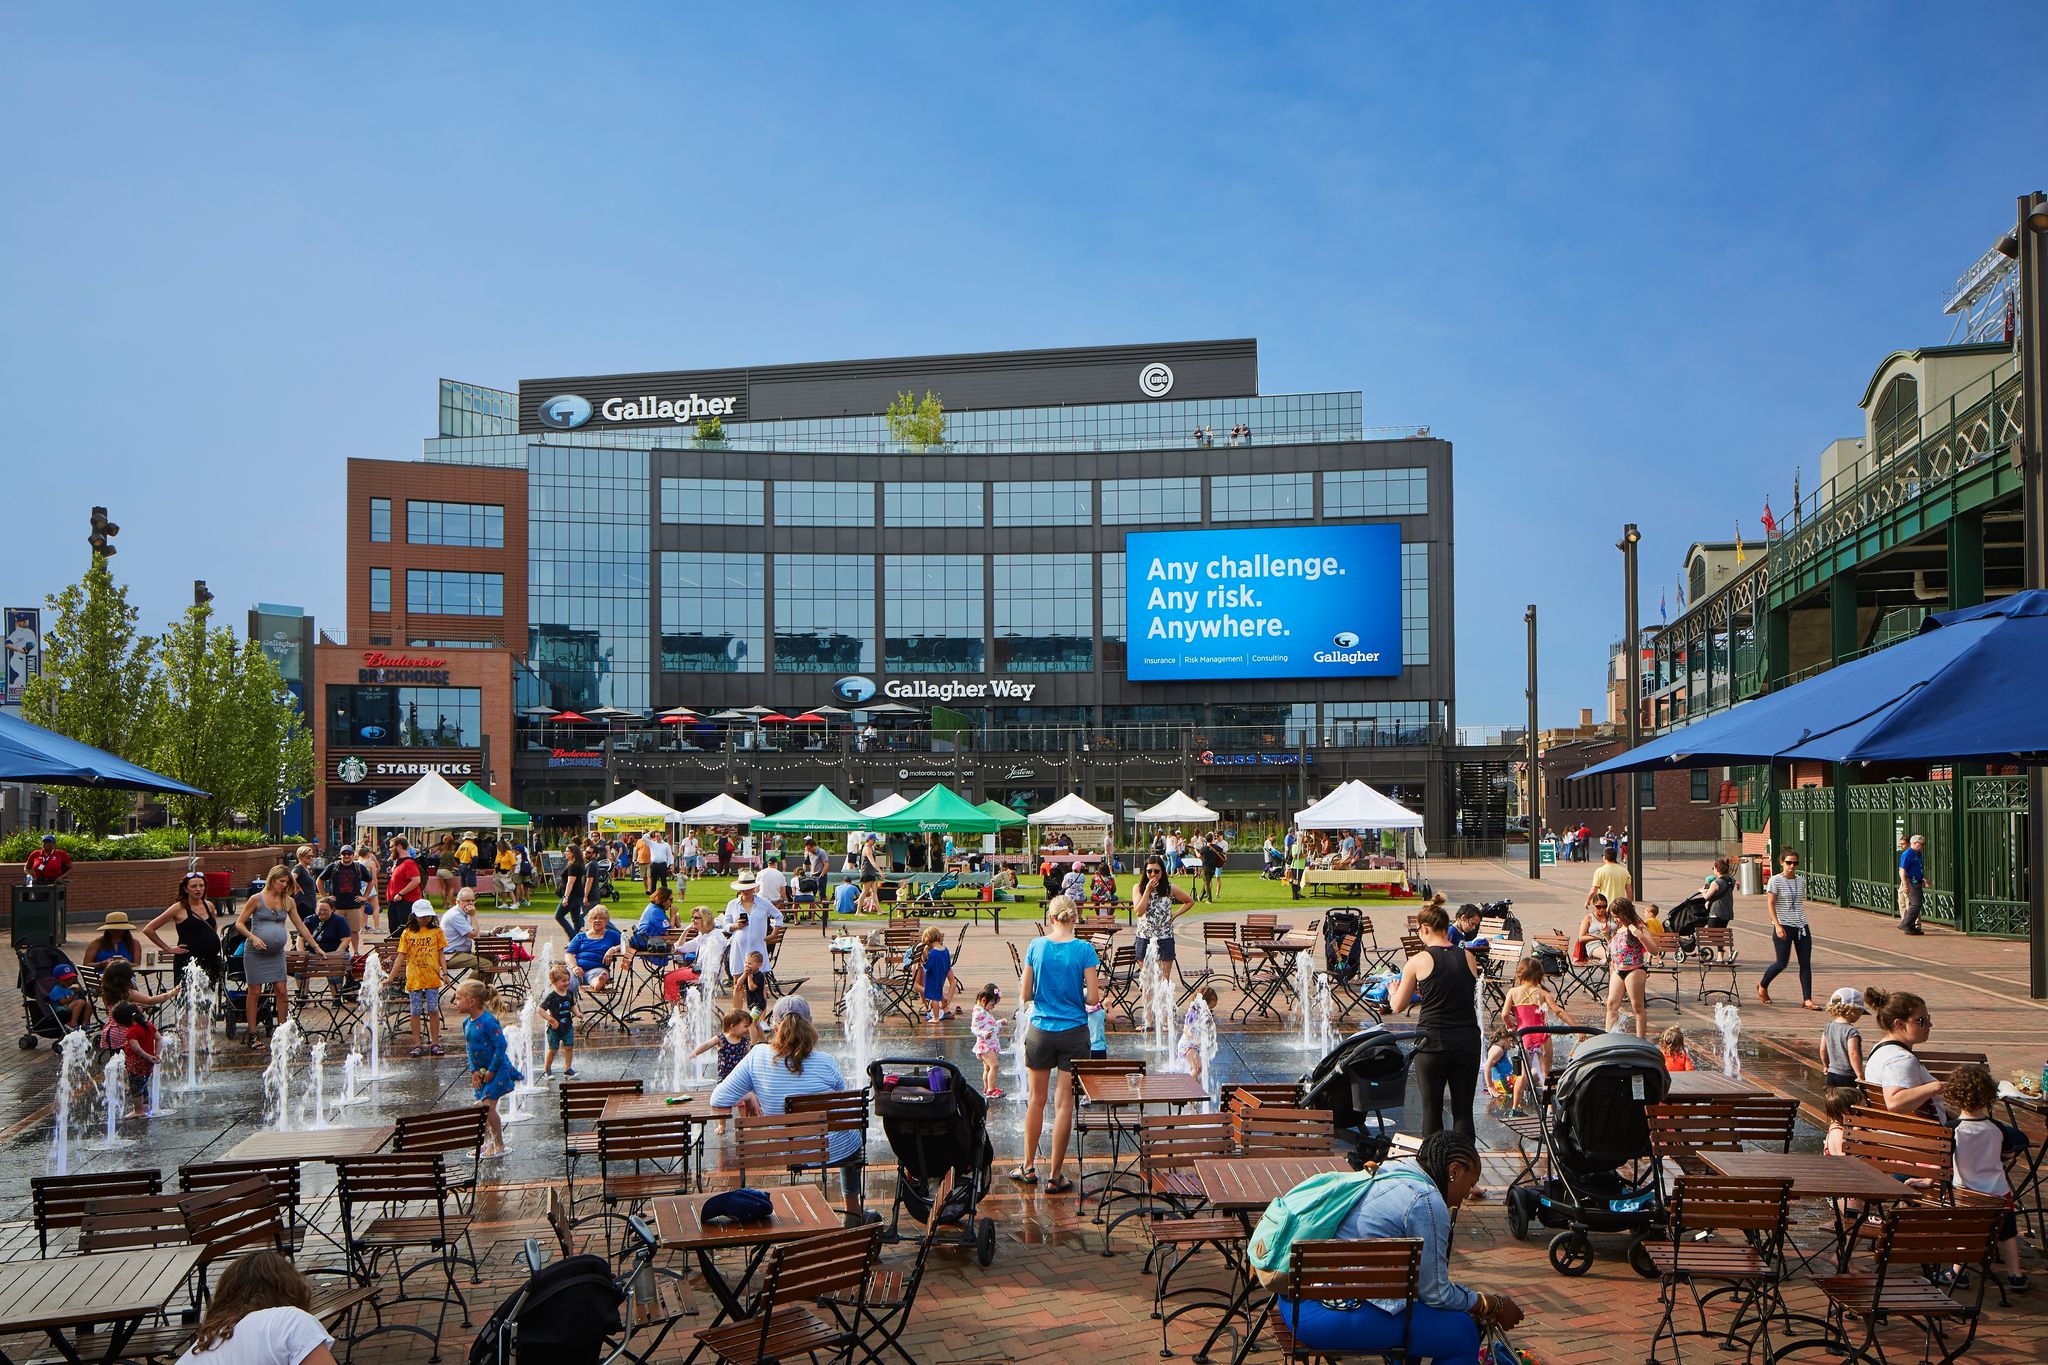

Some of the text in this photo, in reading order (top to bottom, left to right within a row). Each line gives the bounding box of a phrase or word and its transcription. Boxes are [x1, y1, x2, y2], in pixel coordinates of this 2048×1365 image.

[601, 393, 736, 423] Gallagher
[1147, 554, 1346, 584] Any challenge.
[1147, 584, 1262, 613] Any risk.
[1147, 614, 1290, 642] Anywhere.
[263, 640, 299, 648] Gallagher
[273, 646, 288, 655] Way
[364, 651, 447, 668] Budweiser
[1199, 656, 1243, 664] Management
[1252, 654, 1288, 663] Consulting
[1313, 650, 1380, 664] Gallagher
[884, 680, 987, 701] Gallagher
[989, 680, 1035, 701] Way
[550, 747, 600, 758] Budweiser
[1214, 754, 1257, 765] CUBS
[376, 763, 472, 774] STARBUCKS
[937, 770, 955, 778] troph
[410, 937, 431, 946] 2018
